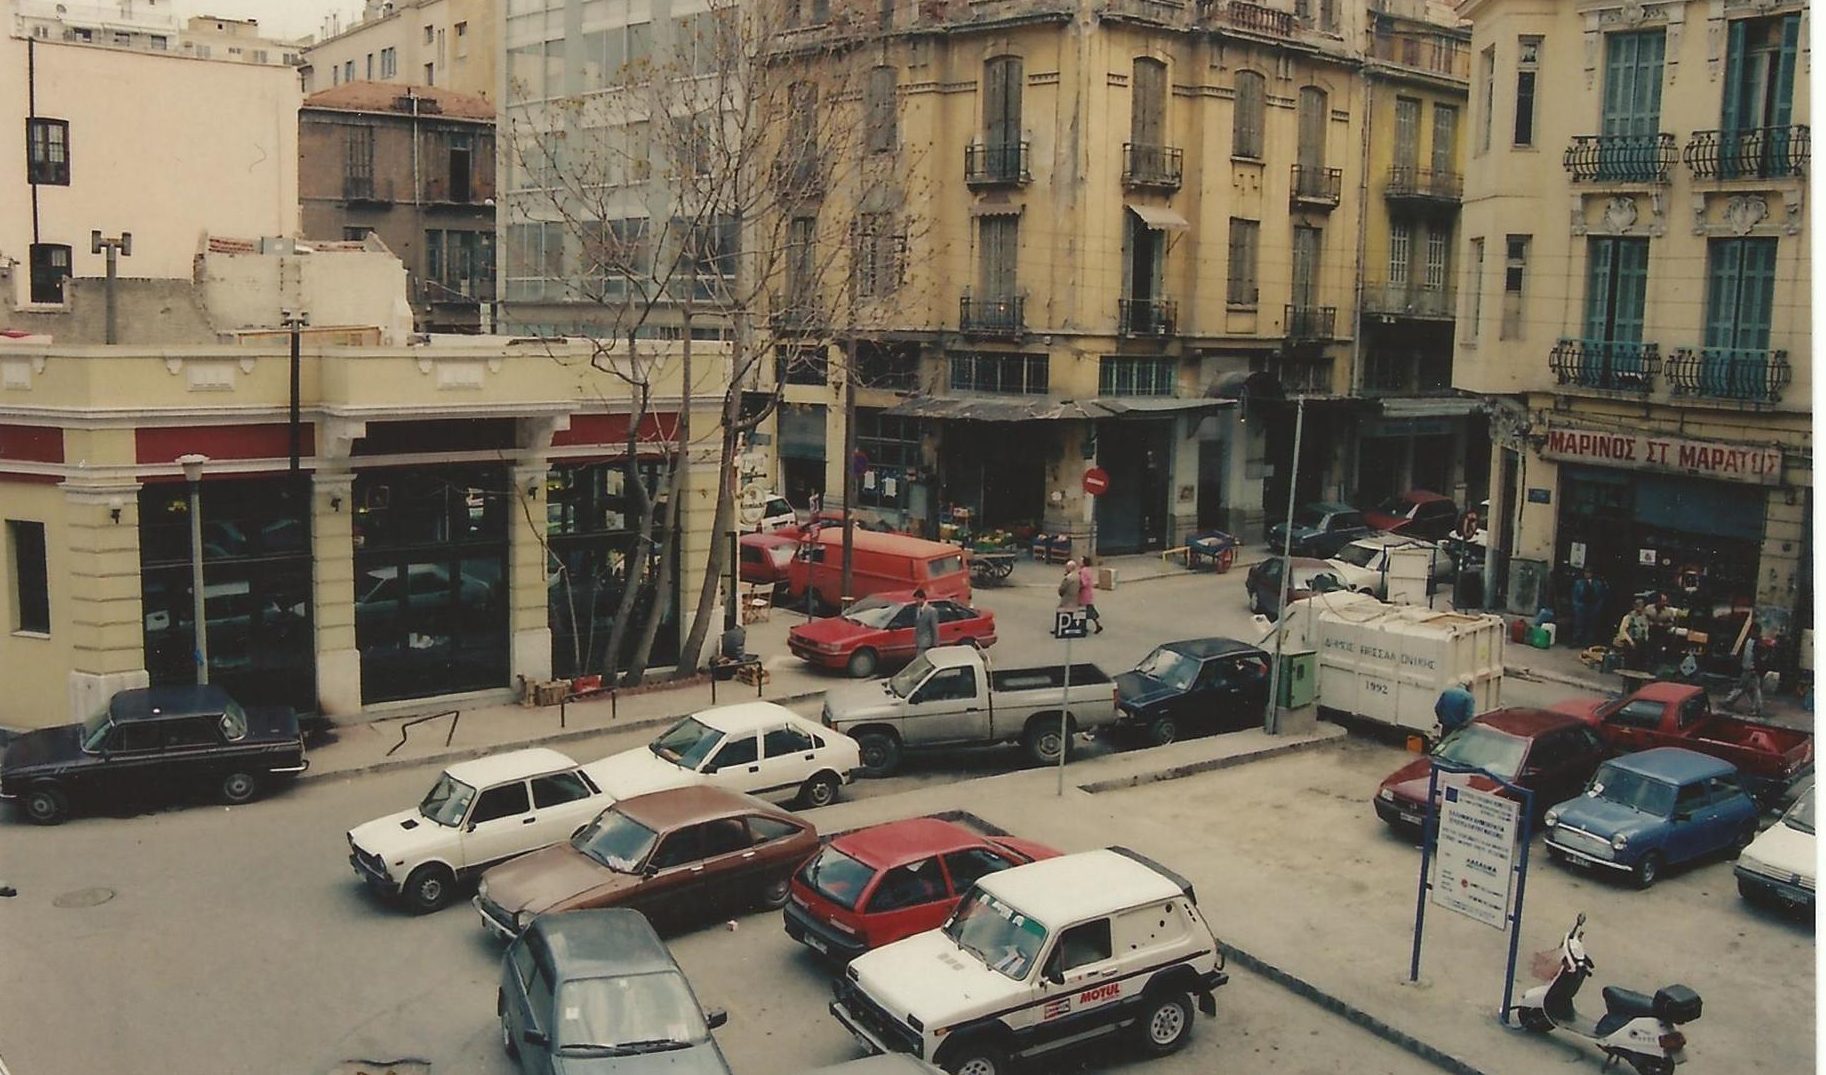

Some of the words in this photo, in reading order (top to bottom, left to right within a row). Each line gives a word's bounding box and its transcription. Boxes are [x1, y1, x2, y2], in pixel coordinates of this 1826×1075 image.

[1549, 430, 1636, 461] ΜΑΡΙΝΟΣ
[1646, 441, 1670, 465] ΣΤ
[1366, 681, 1388, 695] 1992
[1080, 983, 1120, 1004] MOTUL
